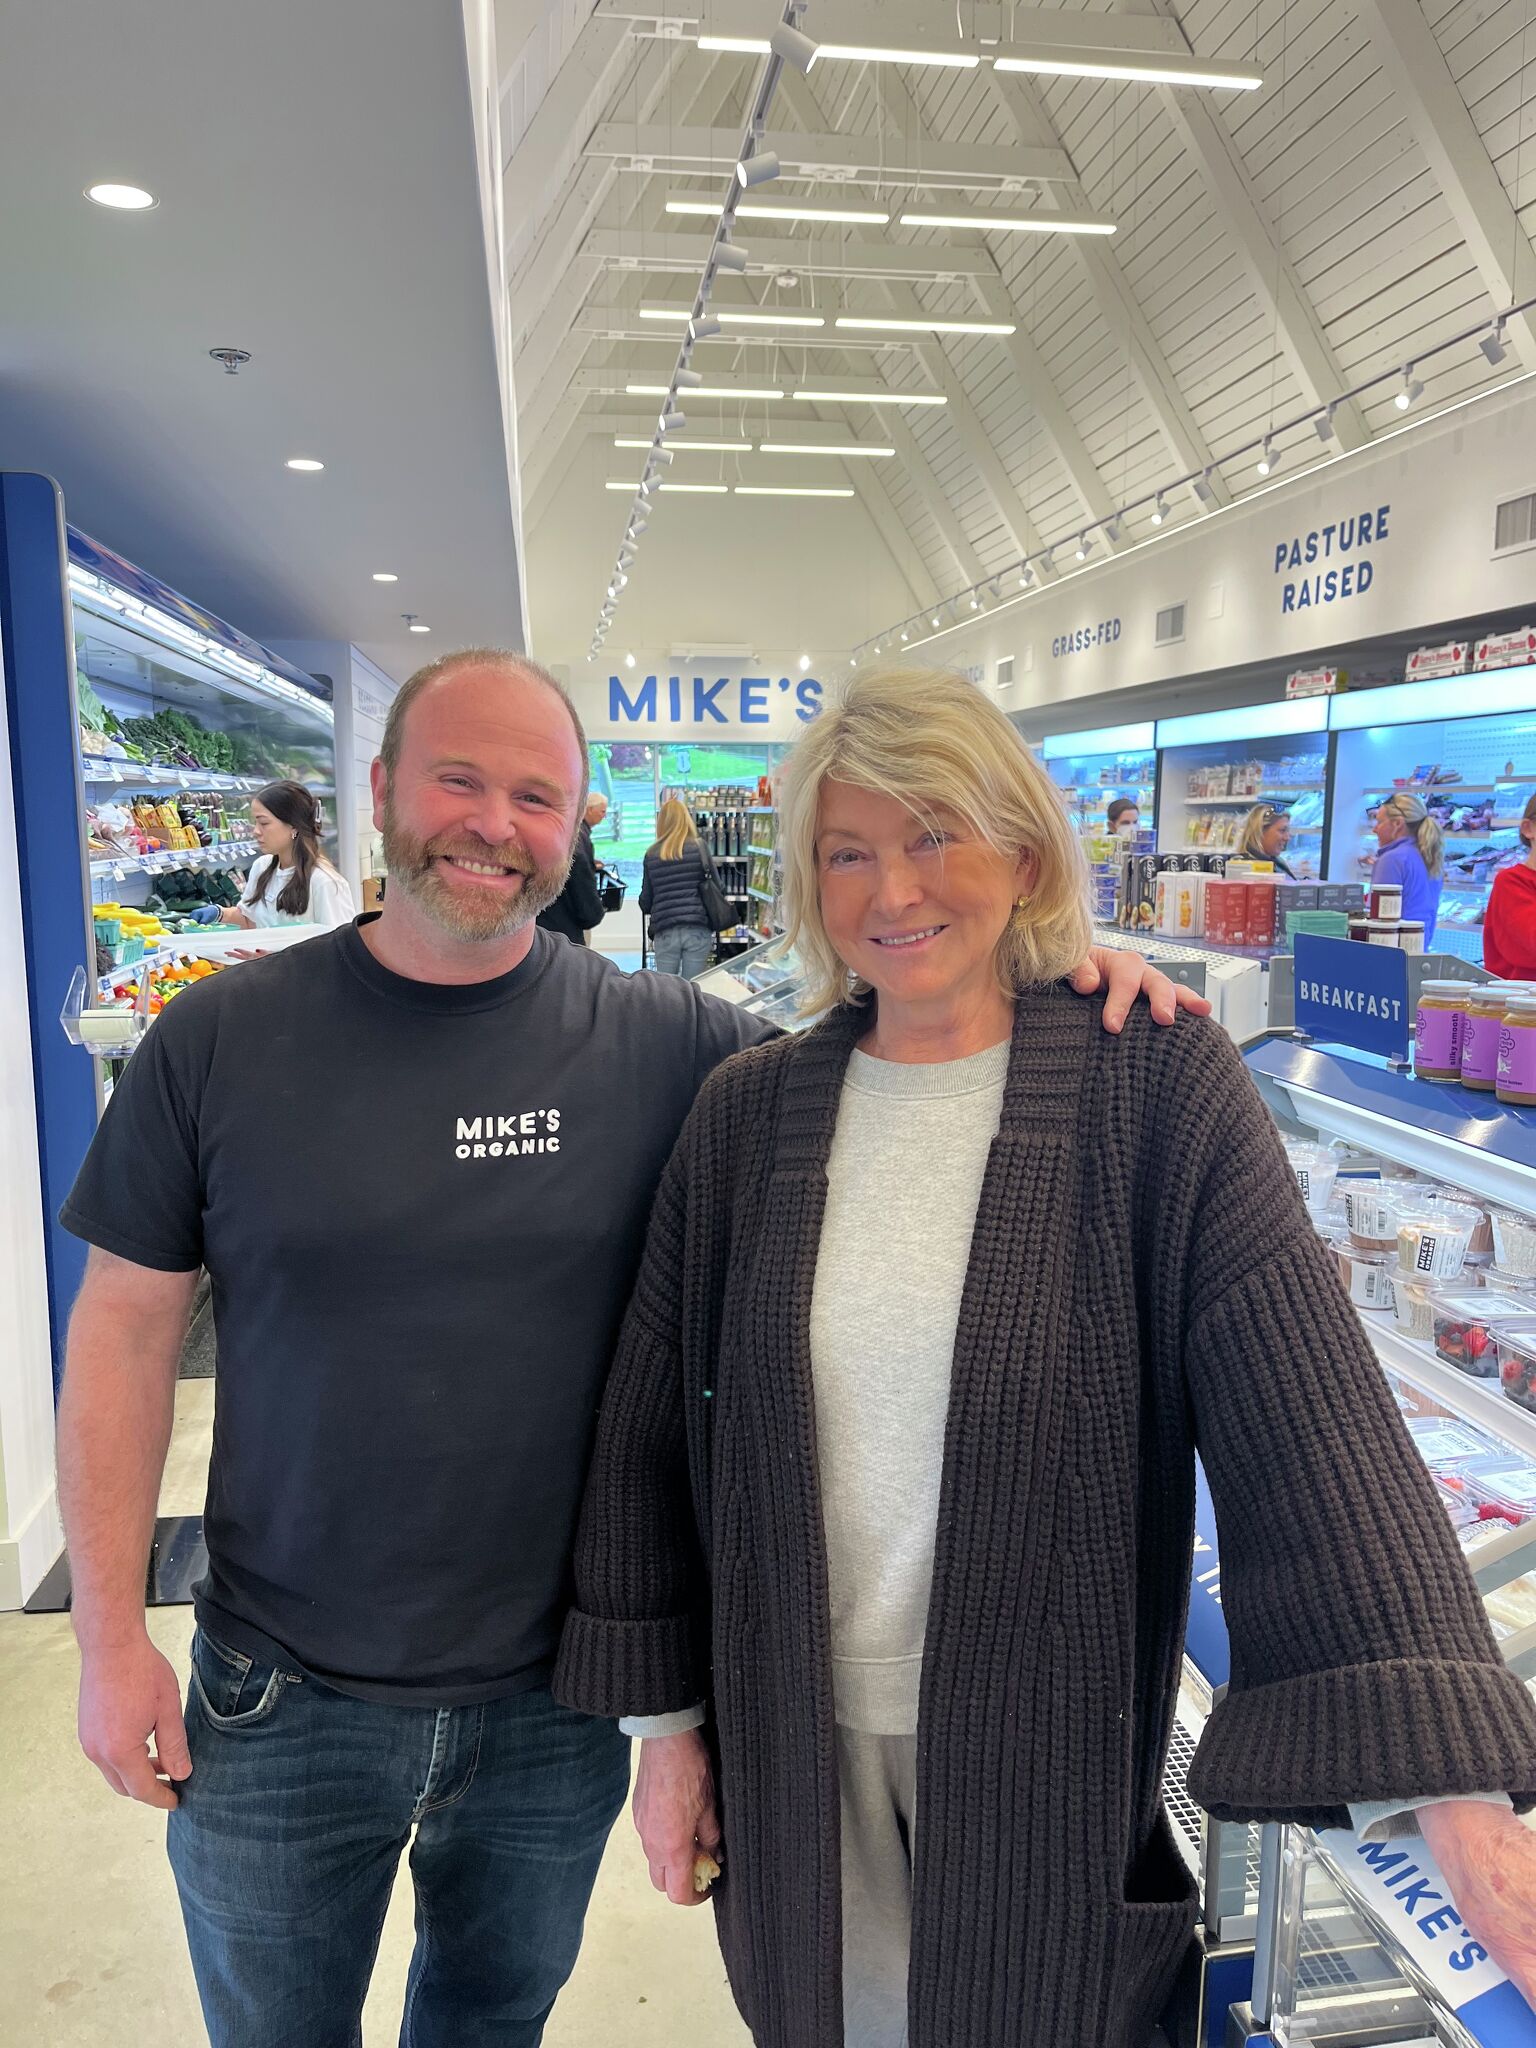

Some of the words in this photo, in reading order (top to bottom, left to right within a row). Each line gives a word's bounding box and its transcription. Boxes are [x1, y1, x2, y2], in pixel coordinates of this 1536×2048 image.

[1274, 504, 1391, 574] PASTURE
[1282, 560, 1374, 614] RAISED
[1052, 618, 1121, 658] GRASS-FED
[609, 676, 823, 724] MIKE'S
[1300, 980, 1401, 1021] BREAKFAST
[1451, 1013, 1459, 1045] smooth
[1449, 1046, 1458, 1066] silky
[456, 1108, 561, 1140] MIKE'S
[455, 1137, 560, 1159] ORGANIC
[1418, 1237, 1430, 1268] MIKE'S
[1357, 1842, 1488, 1971] MIKE'S
